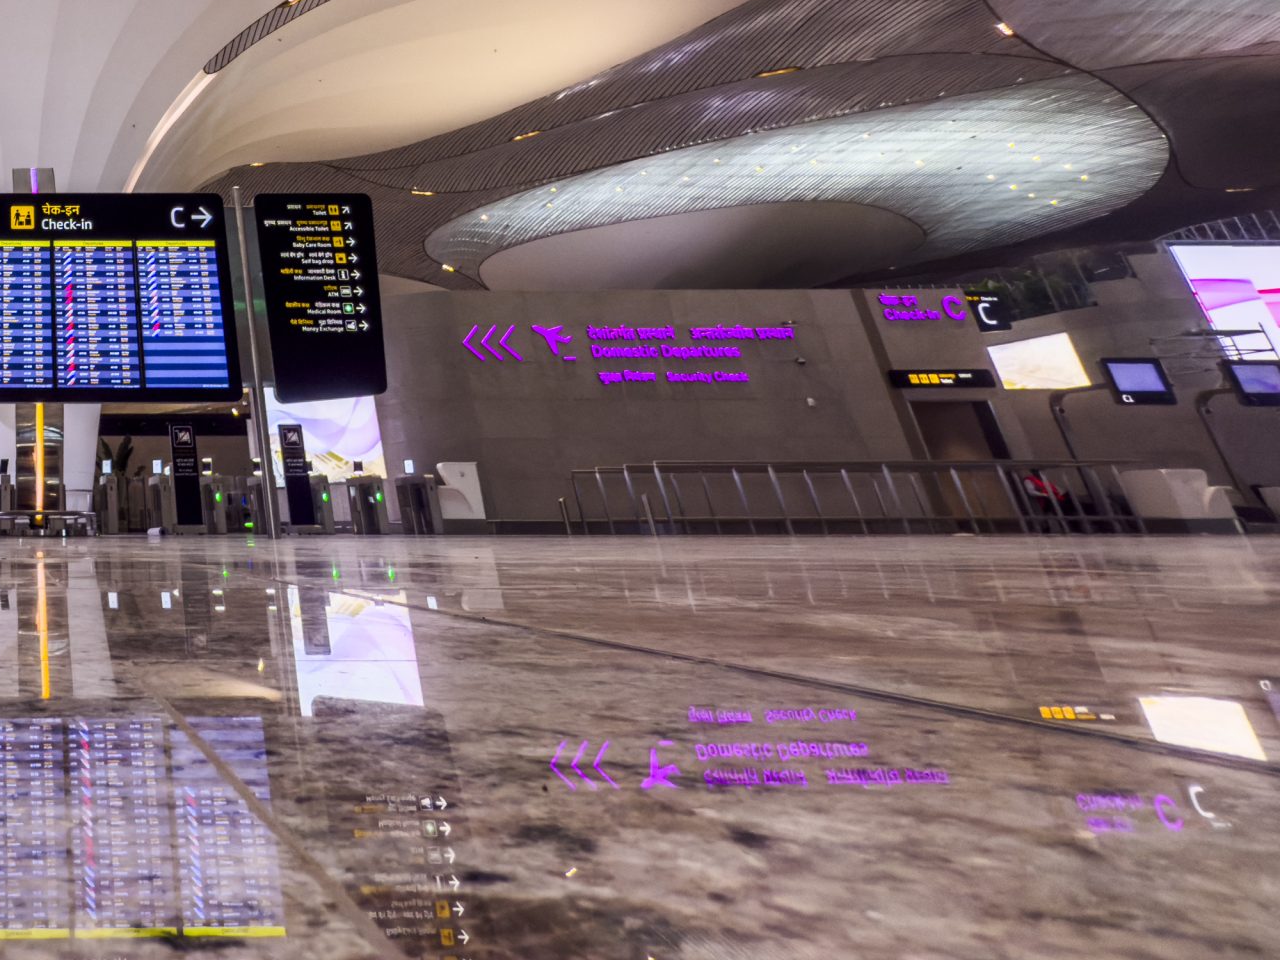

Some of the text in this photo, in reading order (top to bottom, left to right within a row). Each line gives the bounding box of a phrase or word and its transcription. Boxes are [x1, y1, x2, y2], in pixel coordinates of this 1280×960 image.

[42, 202, 80, 216] चेक-इन
[41, 218, 93, 230] Check-in
[170, 207, 186, 229] C
[883, 295, 967, 321] Check-in C
[977, 302, 998, 325] C
[591, 344, 742, 360] Domestic Departures
[666, 371, 750, 384] Security Check
